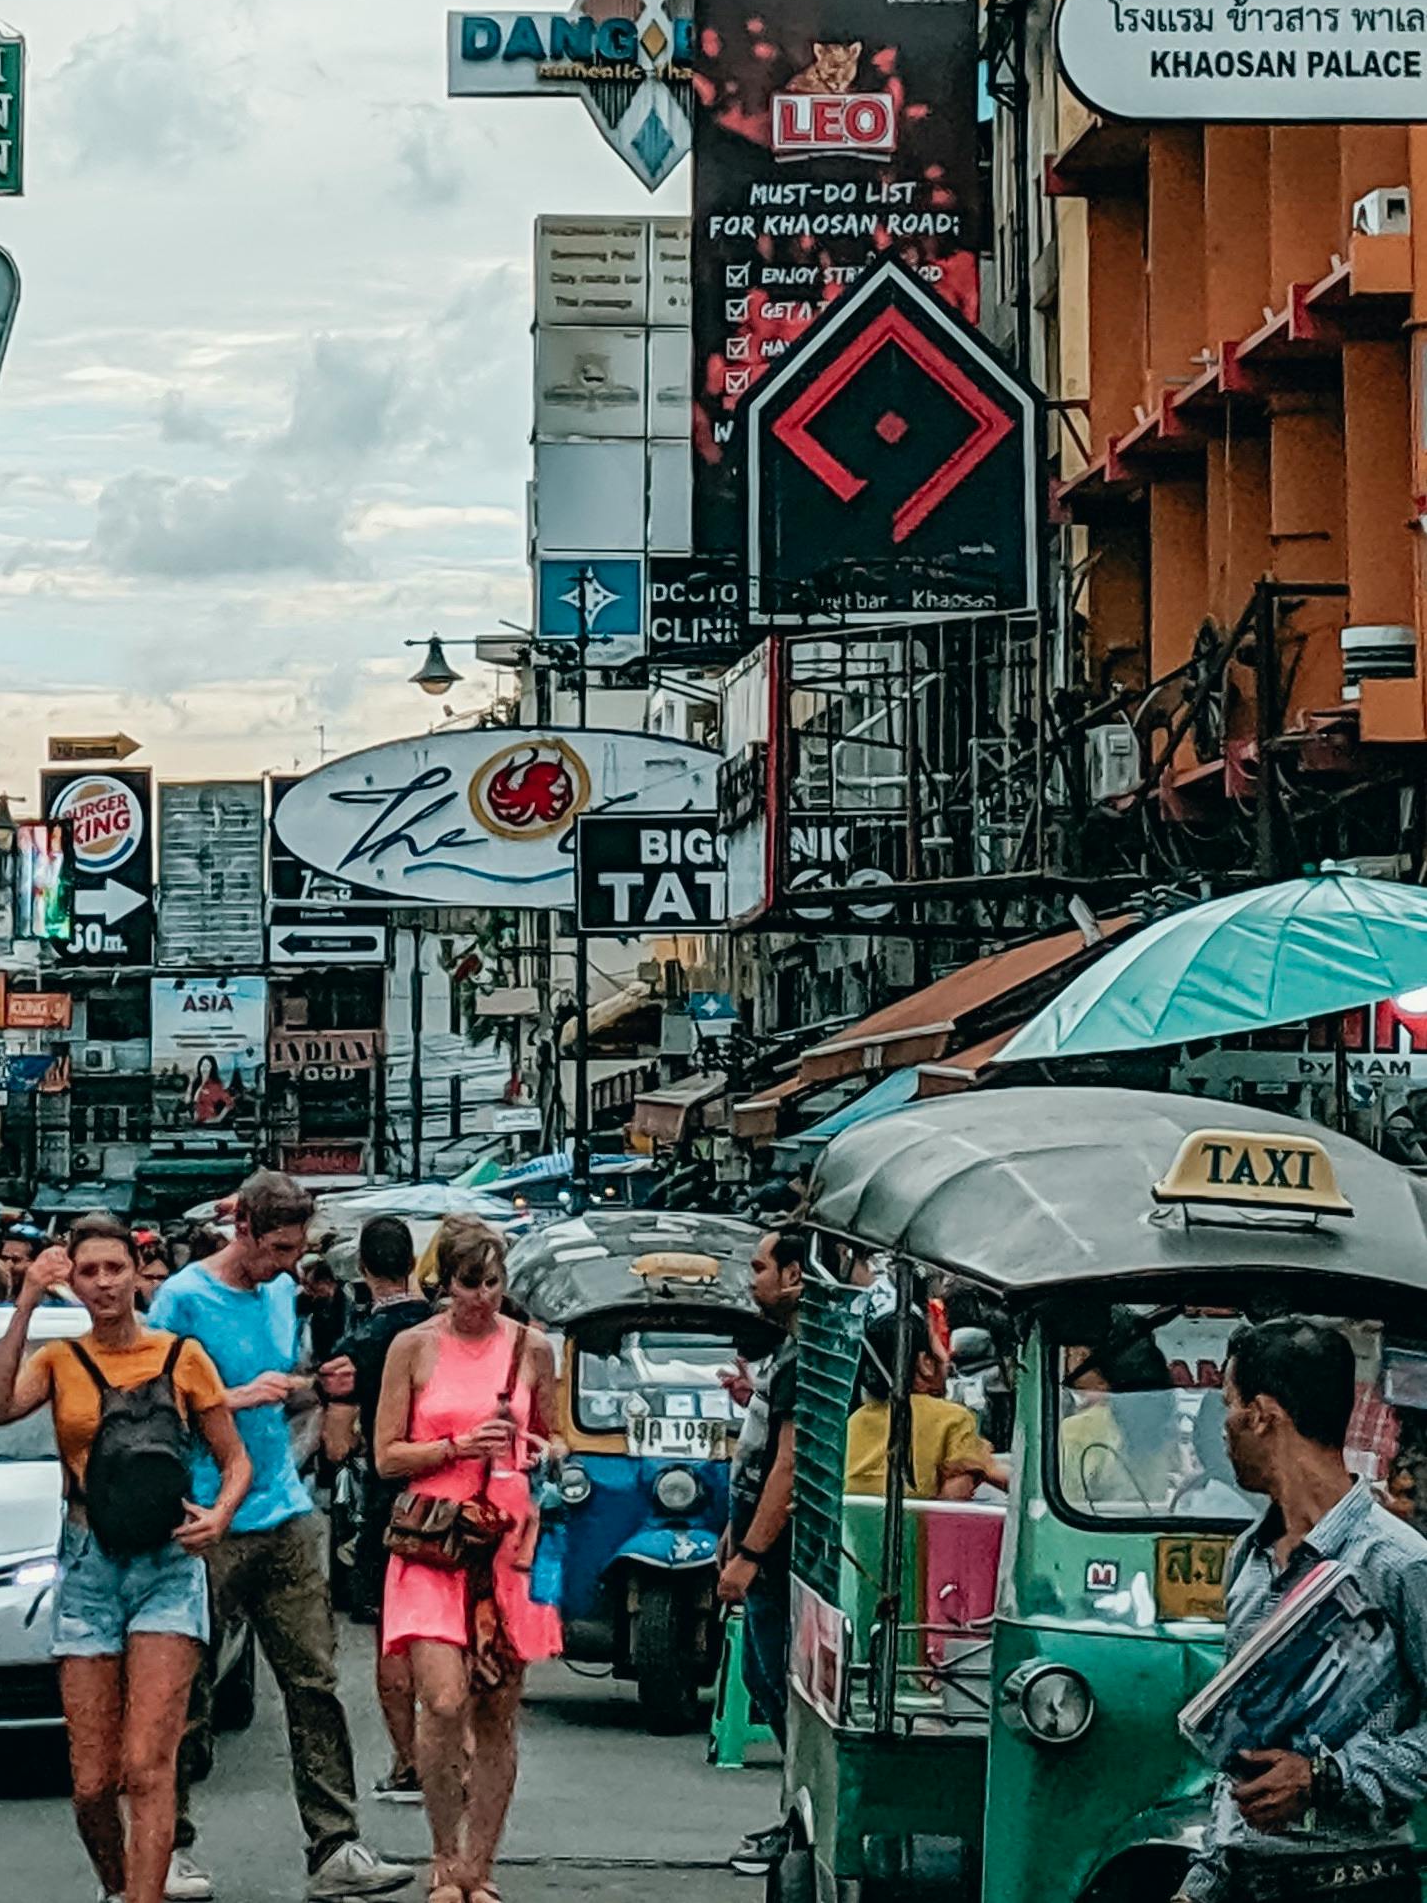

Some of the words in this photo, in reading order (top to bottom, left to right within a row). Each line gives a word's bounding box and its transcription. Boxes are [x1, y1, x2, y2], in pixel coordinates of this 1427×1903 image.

[1350, 3, 1427, 34] พาเล
[461, 15, 640, 62] DANG
[654, 62, 693, 81] Tha
[1150, 49, 1296, 79] KHAOSAN
[1307, 49, 1421, 79] PALACE
[778, 98, 889, 145] LEO
[750, 182, 858, 207] MUST-DO
[865, 181, 918, 205] LIST
[709, 215, 757, 240] FOR
[763, 212, 878, 239] KHAOSAN
[886, 212, 961, 238] ROAD:
[761, 266, 819, 285] ENJOY
[760, 302, 797, 321] GET
[798, 304, 814, 319] A
[651, 617, 740, 644] CLINI
[73, 809, 131, 846] KING
[328, 766, 488, 871] The
[181, 994, 234, 1013] ASIA
[1298, 1057, 1333, 1076] by
[1346, 1059, 1411, 1076] MAM
[1200, 1143, 1317, 1190] TAXI
